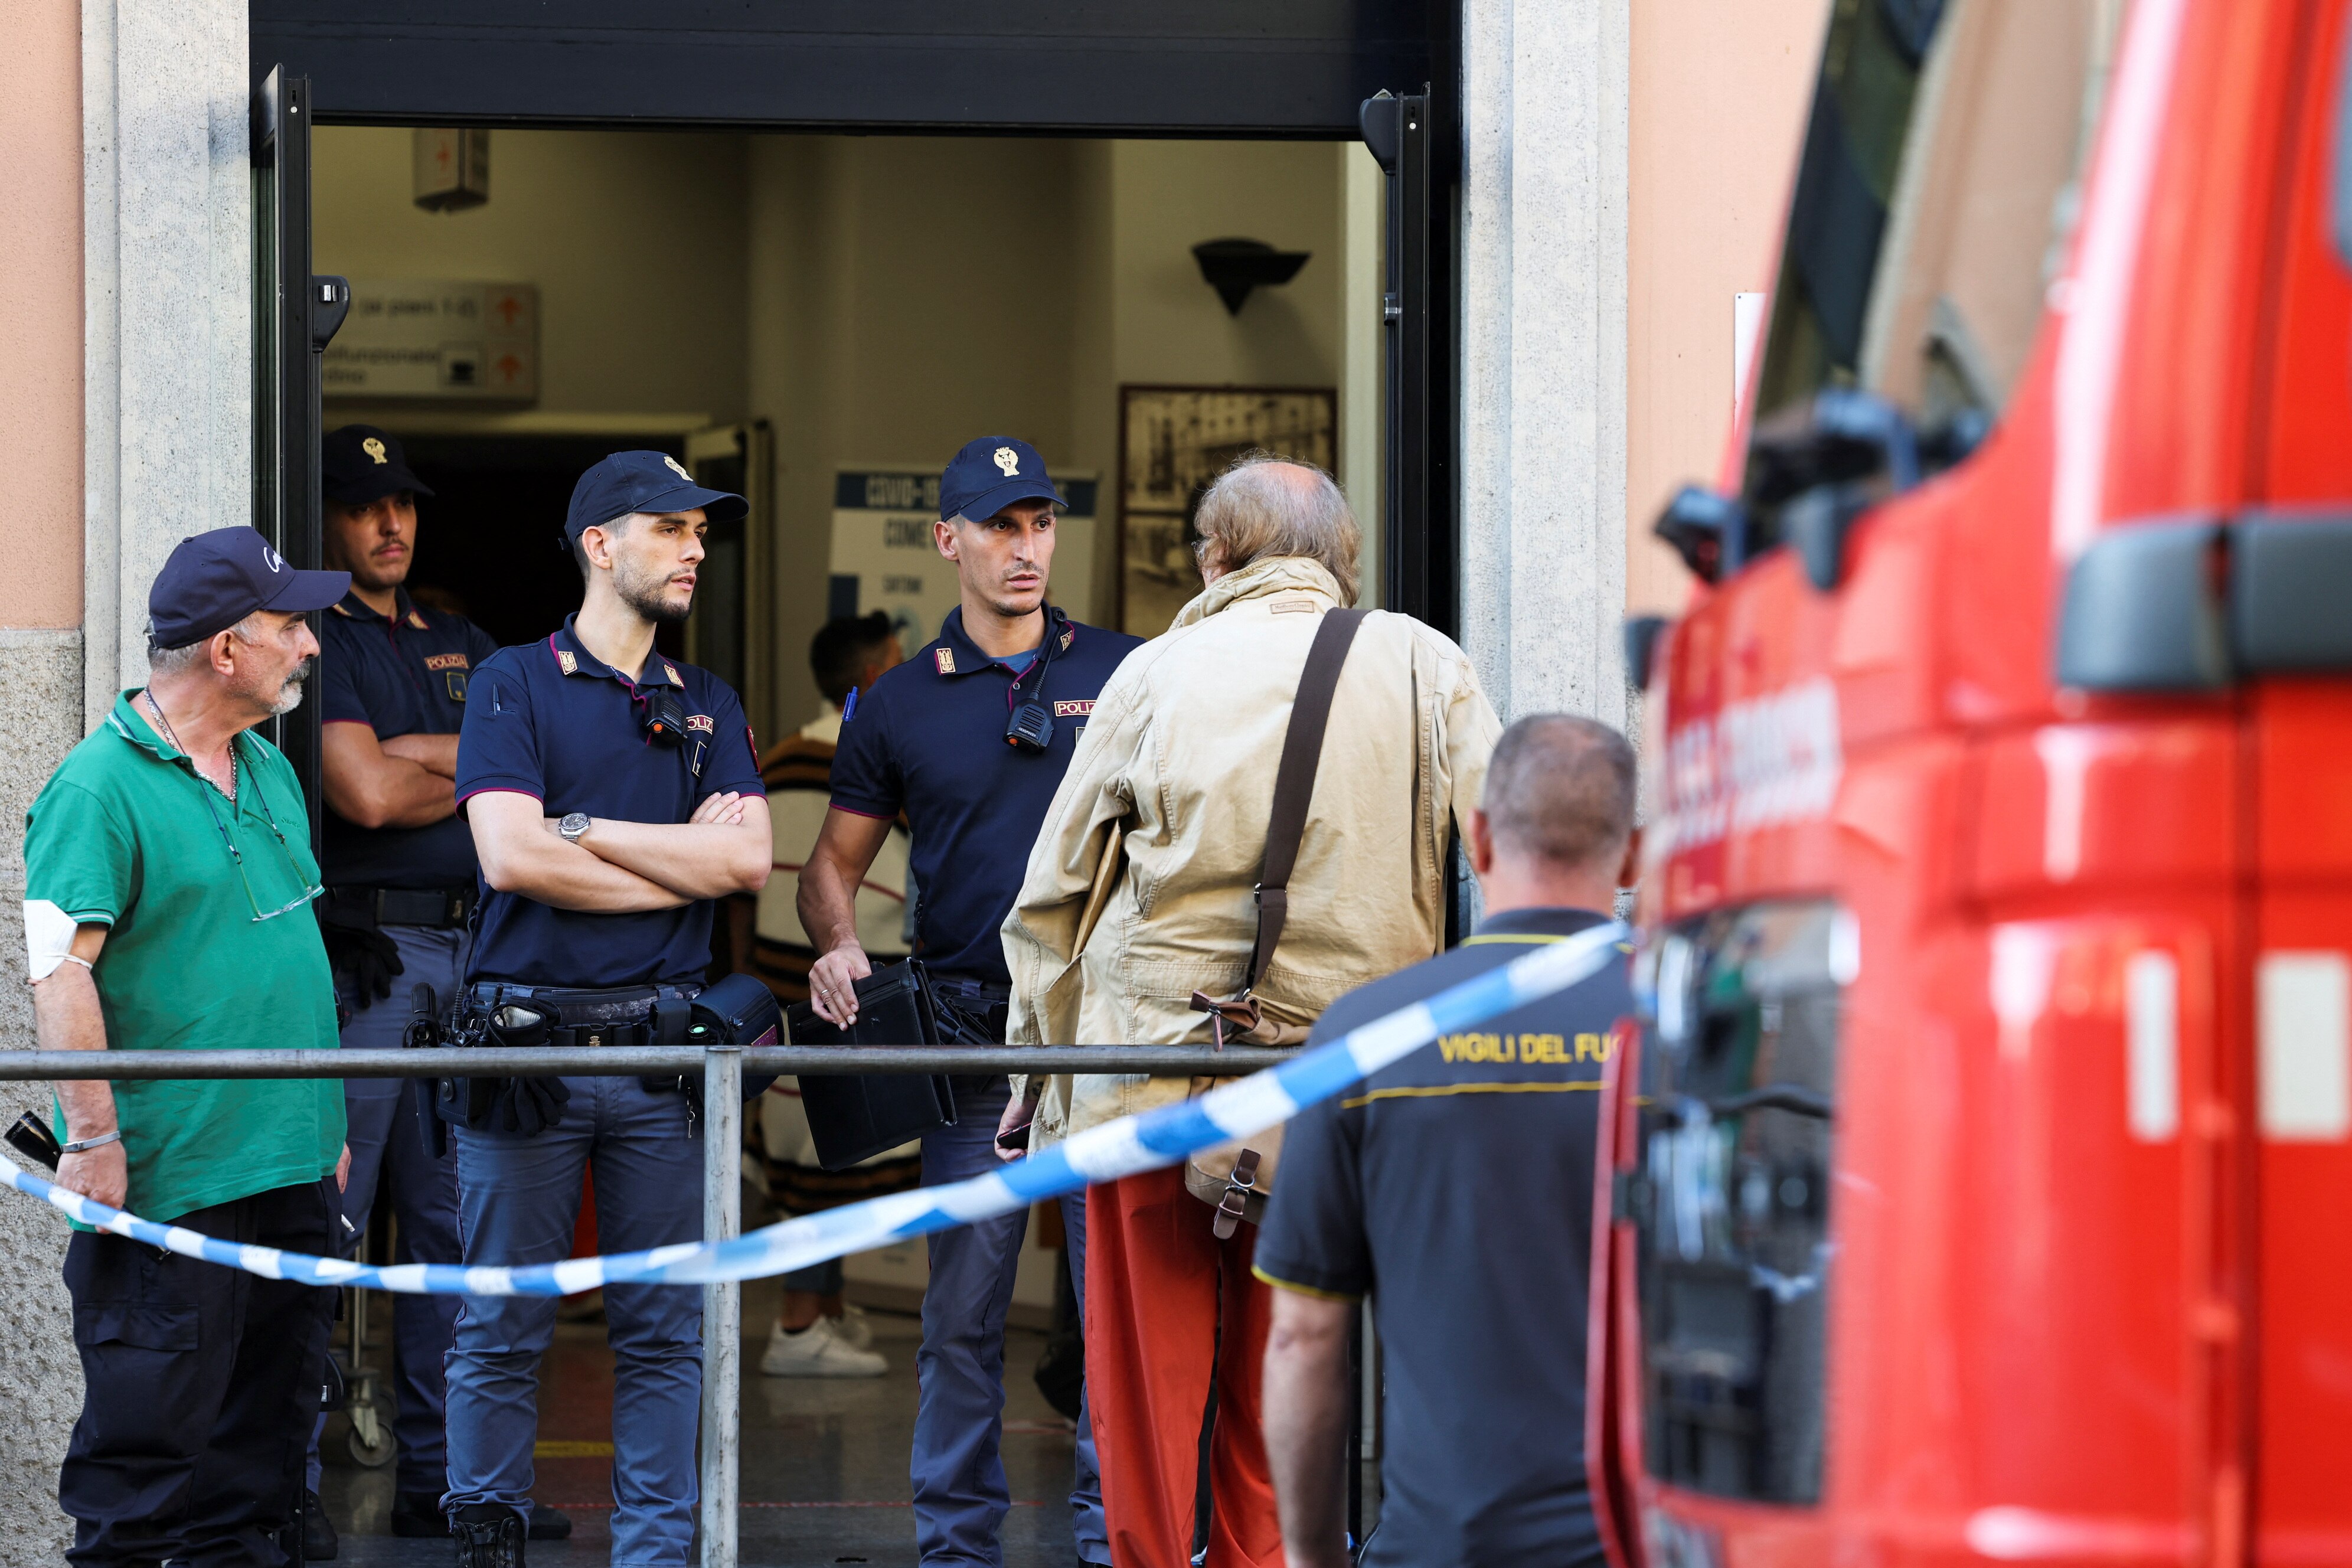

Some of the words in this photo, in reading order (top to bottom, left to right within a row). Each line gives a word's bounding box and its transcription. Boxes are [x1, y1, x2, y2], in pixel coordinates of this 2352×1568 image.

[427, 655, 465, 669] POLIZIA
[1057, 702, 1096, 714] POLIZ
[687, 717, 713, 732] OLIZ
[1018, 727, 1037, 737] KENWOOD
[1438, 1032, 1516, 1063] VIGILI
[1518, 1033, 1573, 1063] DEL
